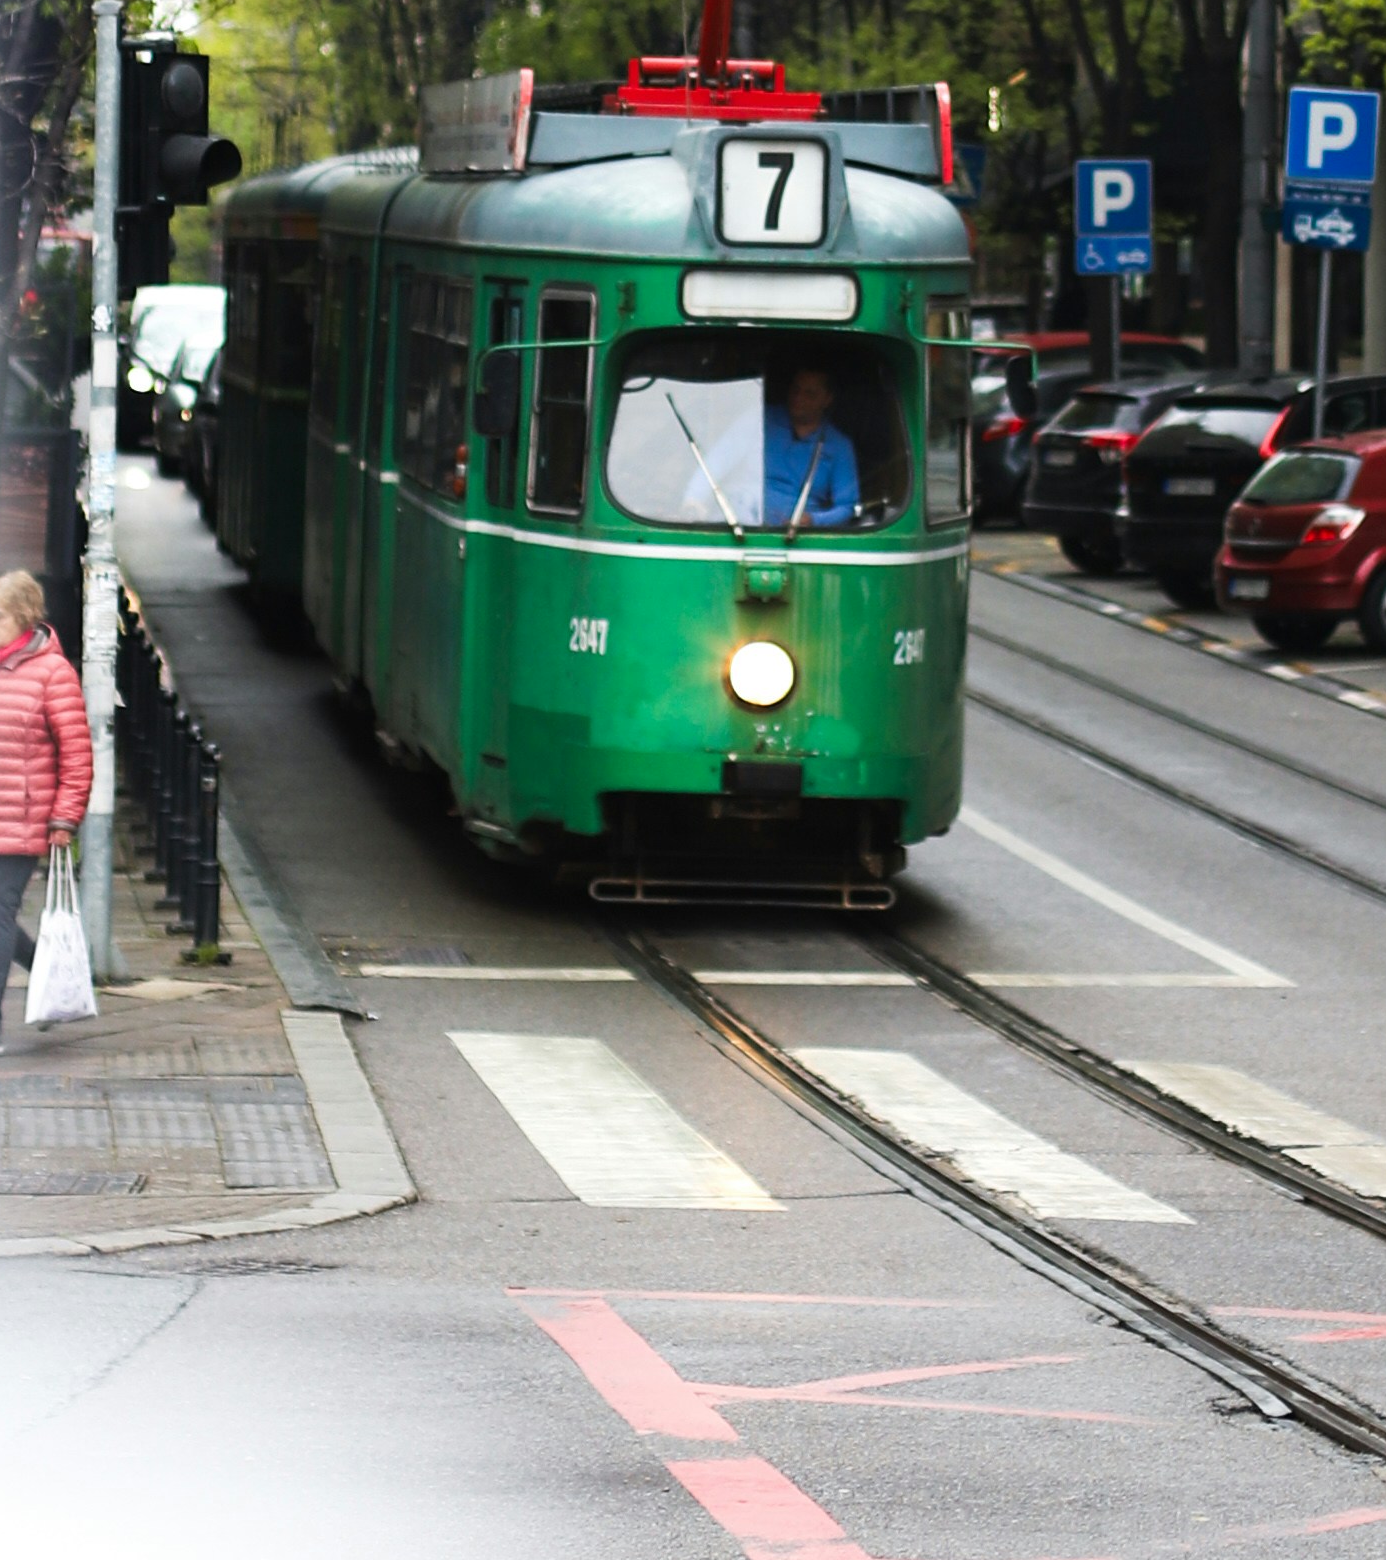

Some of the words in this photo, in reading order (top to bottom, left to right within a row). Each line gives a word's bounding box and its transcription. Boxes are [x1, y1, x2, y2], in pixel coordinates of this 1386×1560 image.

[1307, 100, 1358, 169] P
[758, 152, 794, 231] 7
[1092, 169, 1135, 228] P
[569, 618, 609, 656] 2647
